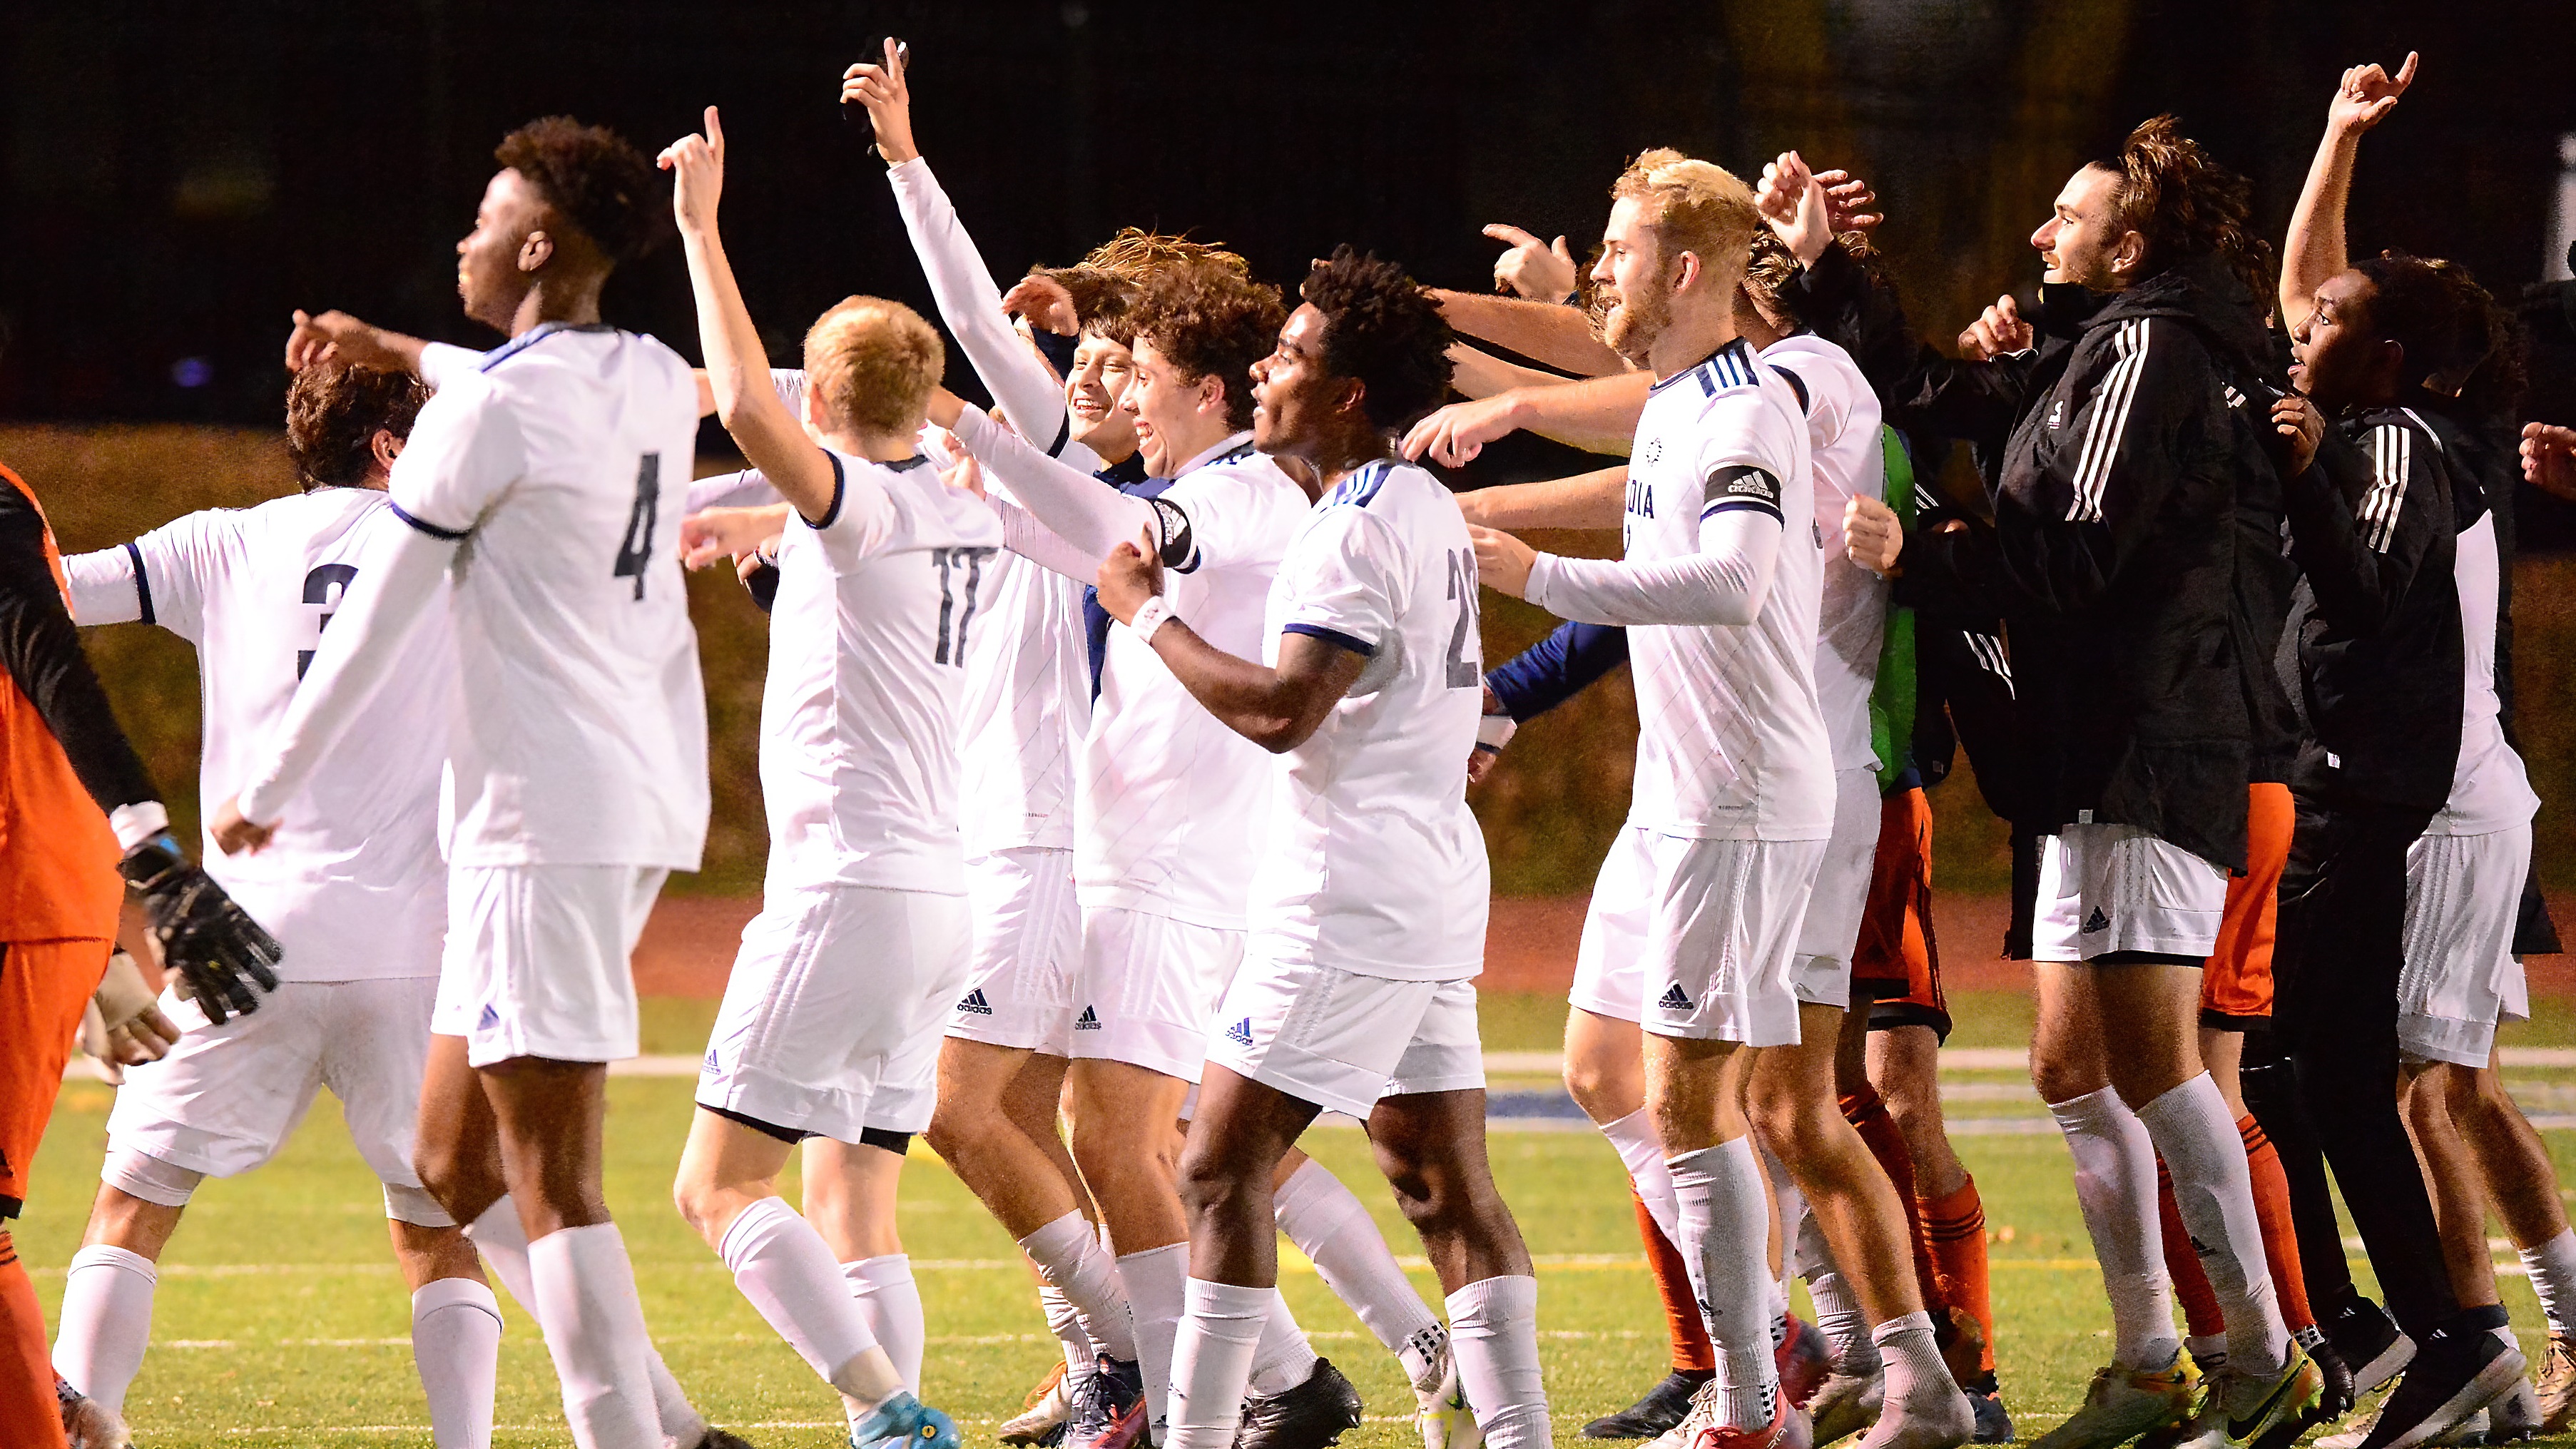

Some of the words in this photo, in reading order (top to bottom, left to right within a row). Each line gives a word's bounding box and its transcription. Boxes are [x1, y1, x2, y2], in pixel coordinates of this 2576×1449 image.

[1728, 484, 1774, 499] adidas
[614, 453, 660, 601] 4
[957, 1003, 992, 1015] adidas
